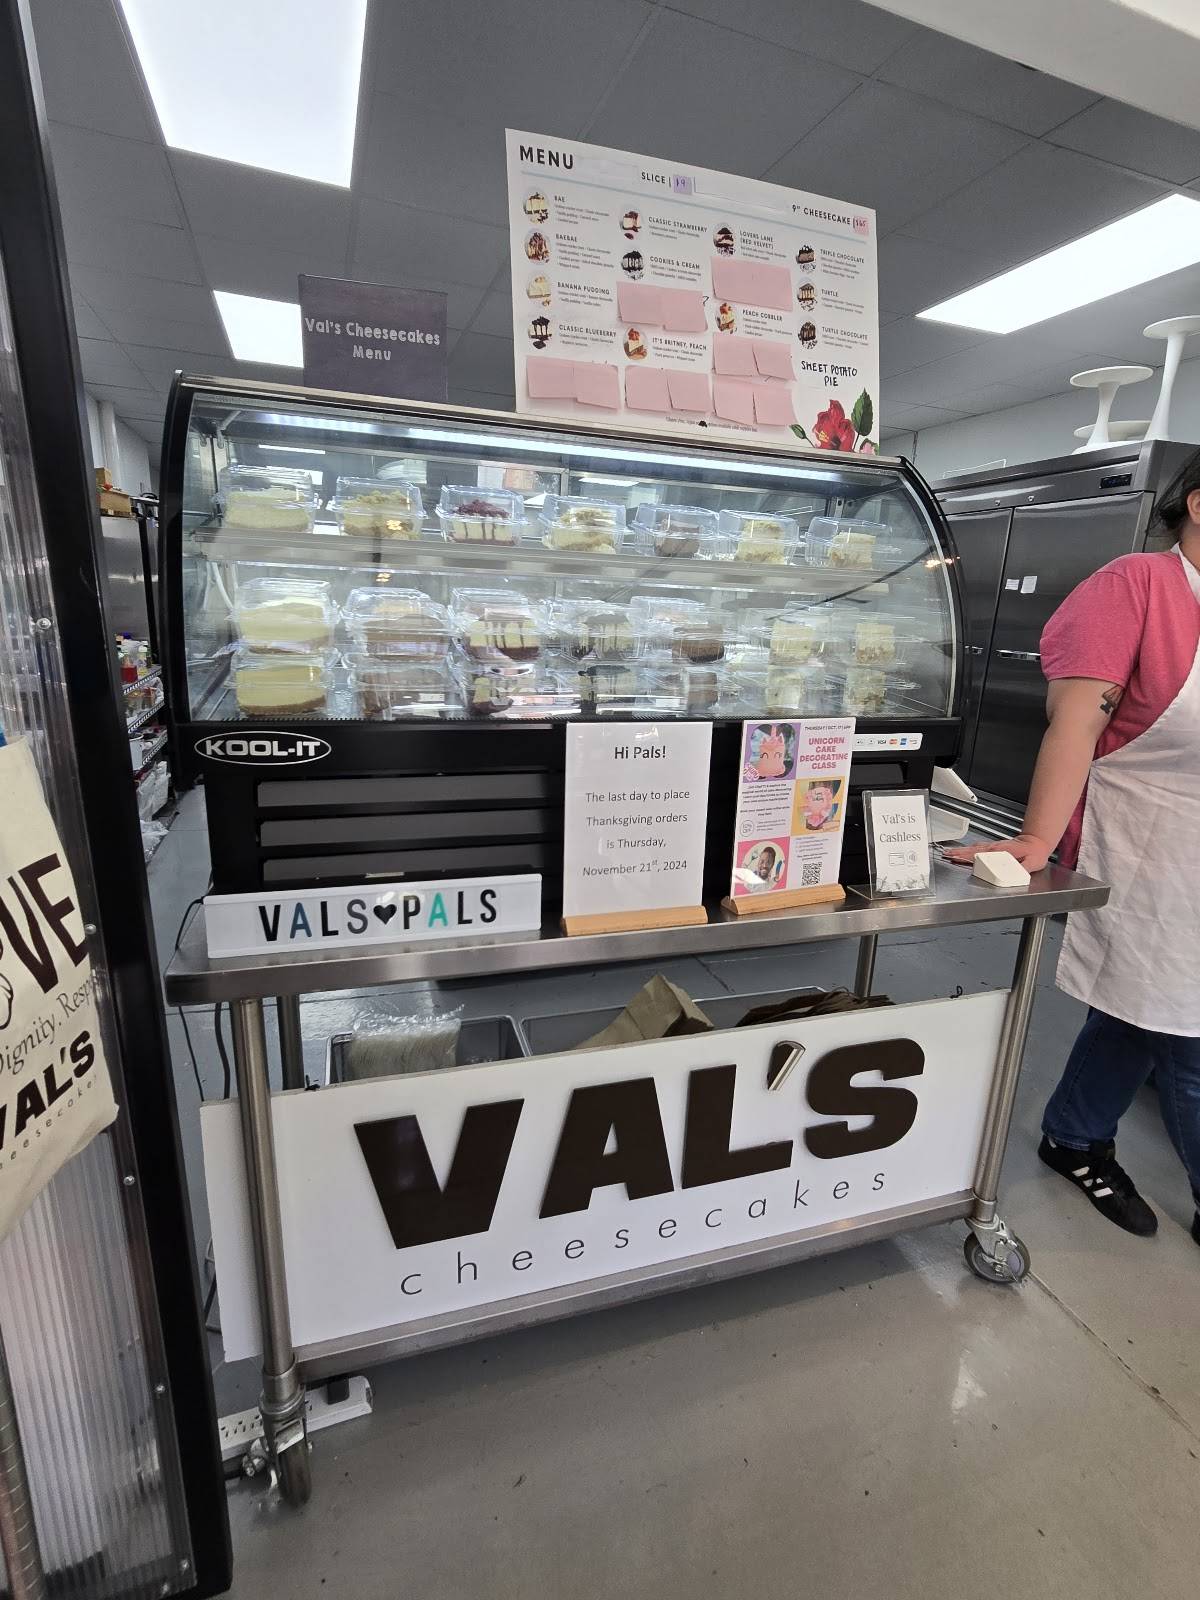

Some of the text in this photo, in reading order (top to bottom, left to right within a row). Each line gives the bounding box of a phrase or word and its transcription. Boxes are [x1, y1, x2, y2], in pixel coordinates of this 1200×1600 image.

[519, 145, 574, 170] MENU
[641, 171, 666, 184] SLICE
[554, 195, 566, 203] BAE
[803, 207, 851, 226] CHEESECAKE
[648, 216, 672, 226] CLASSIC
[673, 221, 708, 233] STRAWBERRY
[555, 233, 578, 242] BAEBAE
[740, 230, 773, 243] LOVERS LANE
[650, 256, 675, 266] COOKIES
[681, 261, 700, 270] CREAM
[820, 248, 865, 264] TRIPLE CHOCOLATE
[557, 281, 610, 295] BANANA PUDDING
[821, 288, 839, 298] TURTLE
[742, 309, 783, 321] PEACH COBBLER
[304, 317, 441, 346] Val's Cheesecakes
[558, 324, 617, 338] CLASSIC BLUEBERRY
[821, 326, 868, 341] TURTLE CHOCOLATE
[352, 344, 392, 361] Menu
[689, 342, 707, 351] PEACH
[801, 360, 858, 377] SWEET POTATO
[823, 375, 839, 387] PIE
[204, 739, 321, 758] KOOL-IT
[808, 737, 845, 746] UNICORN
[614, 745, 667, 760] Hi Pals!
[815, 745, 837, 753] CAKE
[800, 753, 849, 762] DECORATING
[811, 761, 837, 770] CLASS
[585, 789, 690, 803] The last day to place
[586, 812, 688, 826] Thanksgiving orders
[881, 812, 916, 825] Val's is
[606, 837, 667, 849] is Thursday,
[879, 831, 922, 844] Cashless
[582, 864, 636, 877] November
[663, 859, 688, 871] 2024
[257, 888, 498, 942] VALS PALS
[353, 1037, 926, 1249] VAL'S
[399, 1169, 890, 1297] cheesecakes
